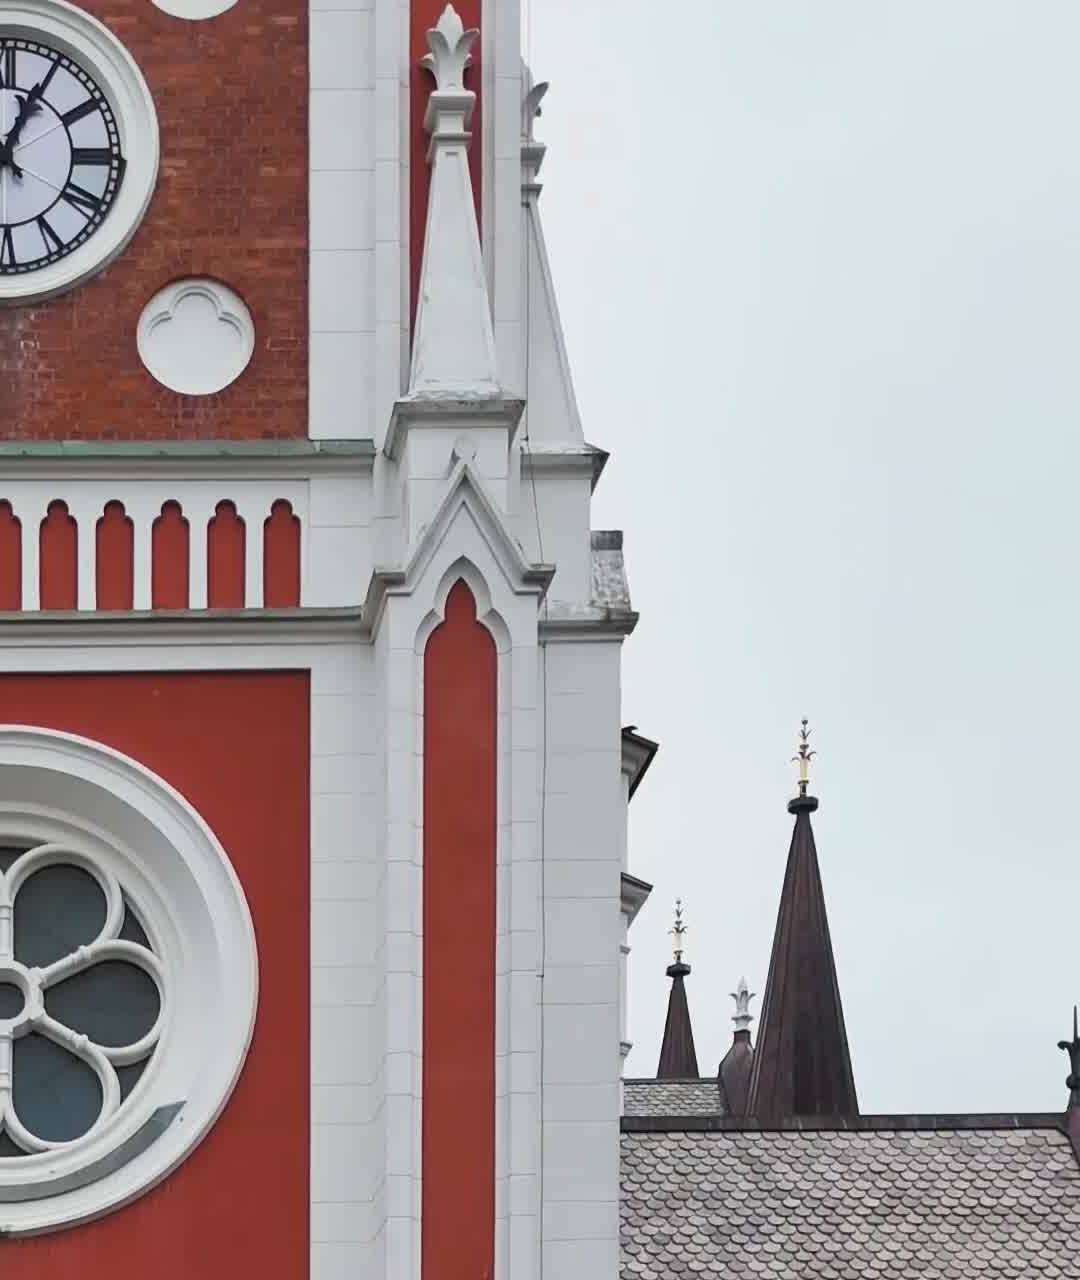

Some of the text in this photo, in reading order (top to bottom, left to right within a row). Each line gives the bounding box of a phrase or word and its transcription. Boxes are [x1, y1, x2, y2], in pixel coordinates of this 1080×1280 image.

[62, 99, 103, 127] II
[71, 147, 113, 165] III
[37, 214, 65, 256] V
